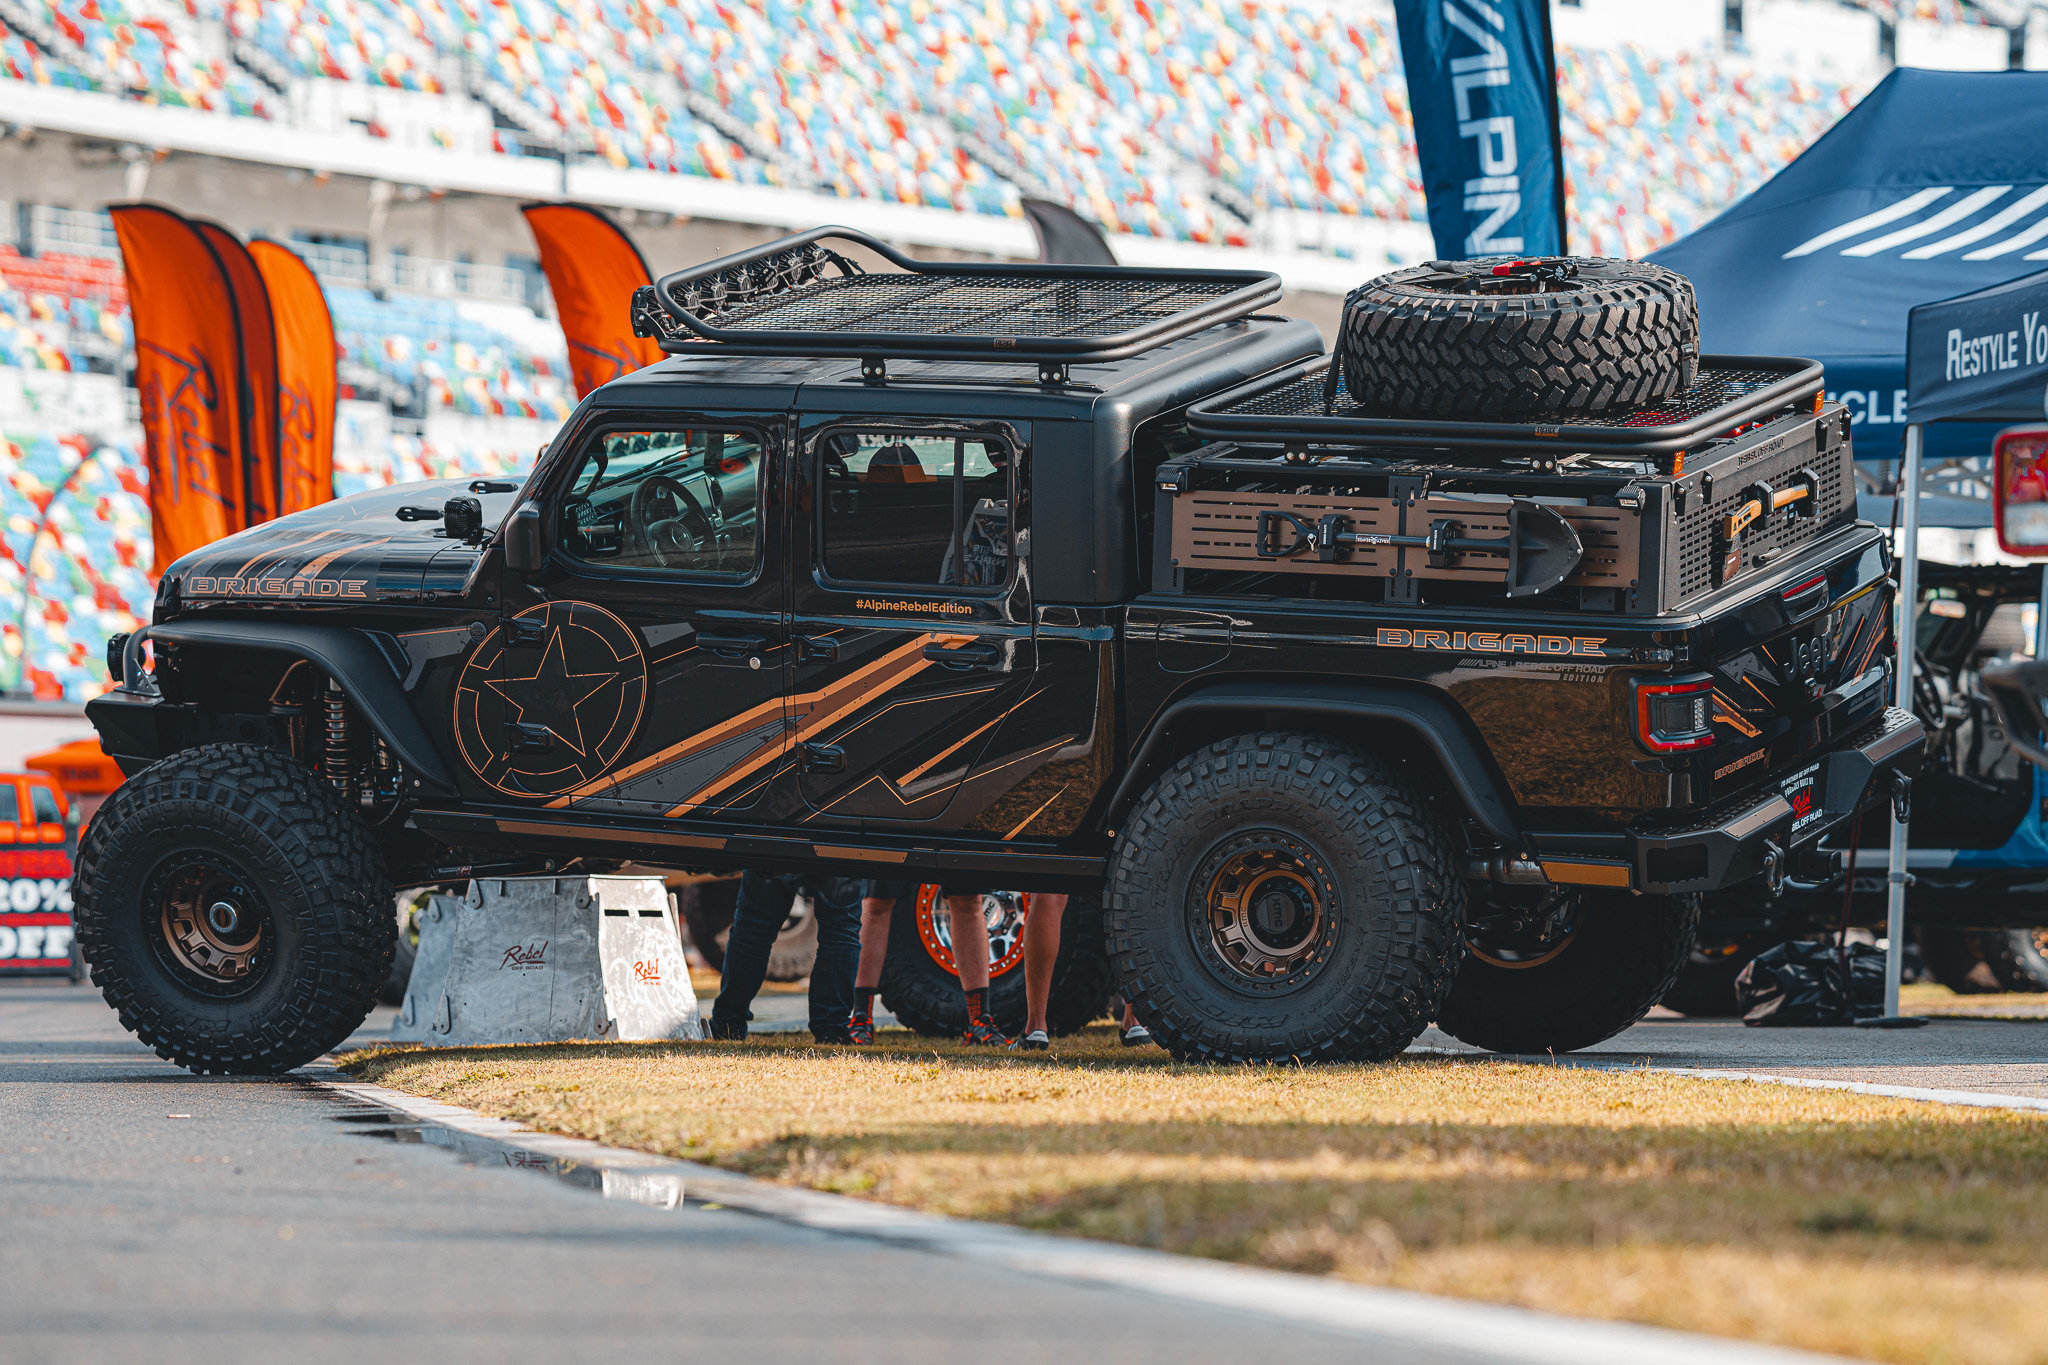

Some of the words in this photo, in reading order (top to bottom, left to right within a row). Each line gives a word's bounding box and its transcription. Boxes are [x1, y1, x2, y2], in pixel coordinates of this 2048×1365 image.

[189, 577, 369, 598] BRIGADE
[855, 599, 973, 615] #AlpineRebelEdition
[1376, 627, 1608, 657] BRIGADE
[1783, 630, 1834, 682] Jeep
[1554, 662, 1574, 672] OFF
[1577, 664, 1606, 674] ROAD
[1562, 673, 1604, 683] EDITION
[499, 940, 549, 970] Rebel
[633, 958, 661, 982] Rebel
